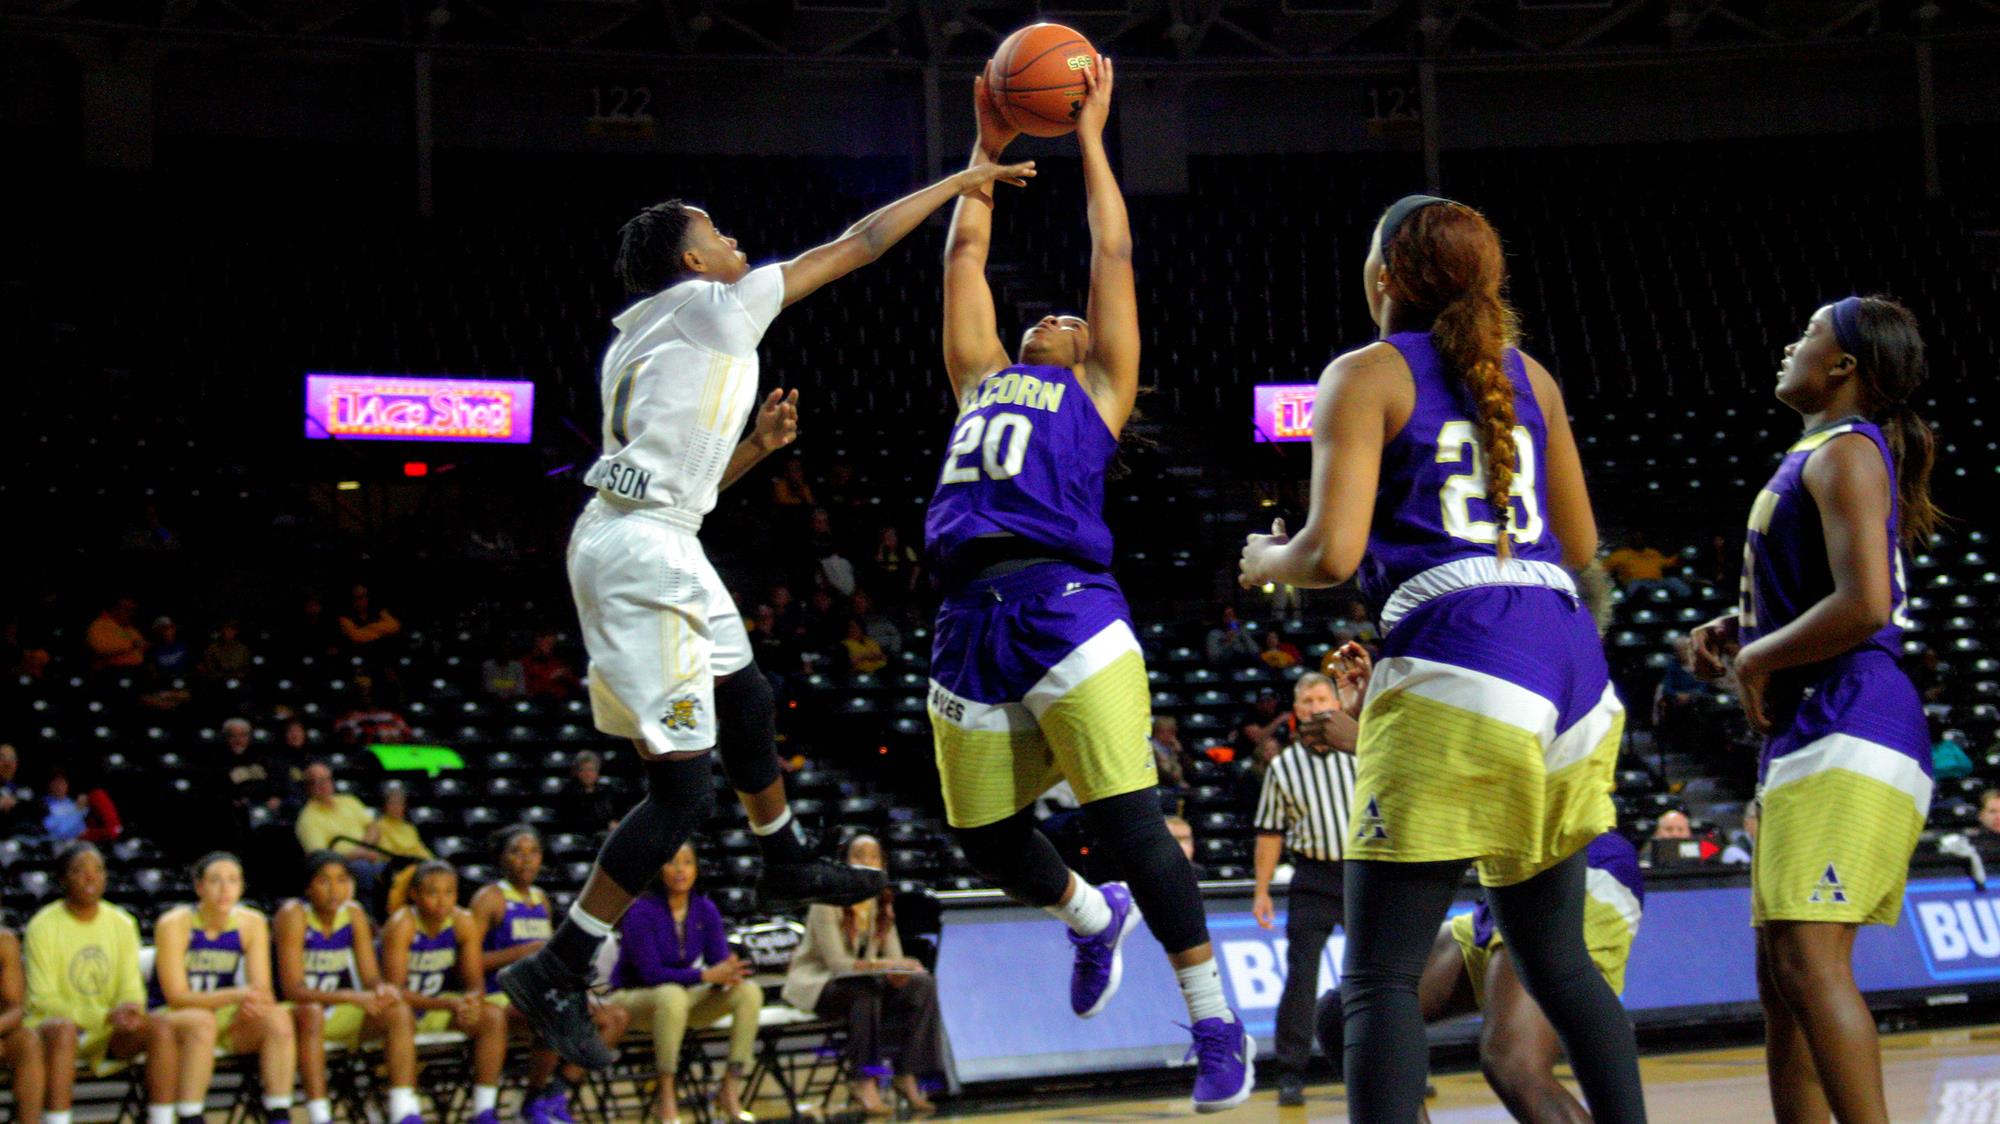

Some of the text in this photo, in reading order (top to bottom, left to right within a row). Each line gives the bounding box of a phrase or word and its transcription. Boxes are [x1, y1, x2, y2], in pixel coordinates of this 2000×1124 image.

[590, 83, 654, 118] 122
[941, 412, 1033, 485] 20
[1434, 420, 1544, 544] 23
[1917, 897, 2000, 961] BU
